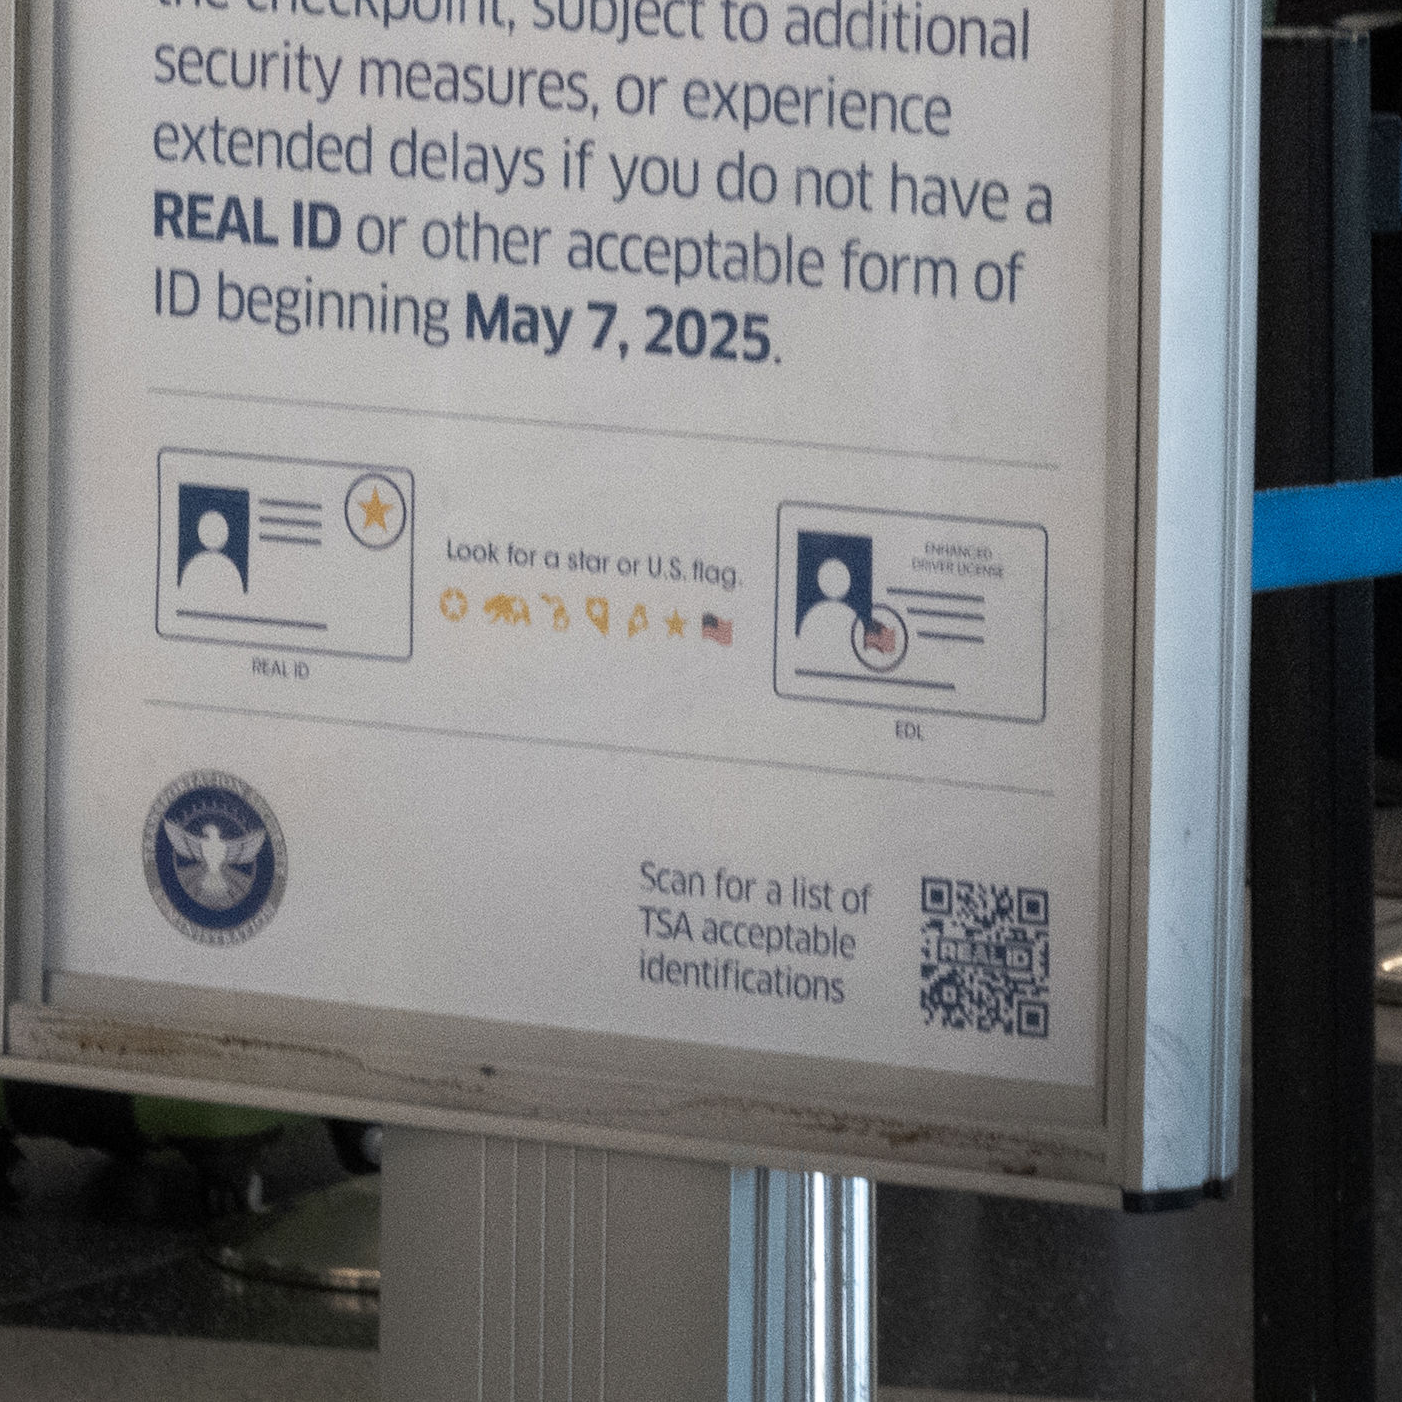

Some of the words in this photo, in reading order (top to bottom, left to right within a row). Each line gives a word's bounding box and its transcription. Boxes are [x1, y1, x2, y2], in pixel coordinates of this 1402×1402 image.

[155, 40, 343, 104] security
[360, 57, 599, 119] measures,
[616, 74, 668, 116] or
[683, 75, 952, 138] experience
[153, 117, 372, 175] extended
[389, 127, 545, 195] delays
[563, 137, 595, 190] if
[609, 153, 699, 204] you
[716, 150, 778, 205] do
[795, 161, 873, 212] not
[890, 161, 1009, 222] have
[1025, 182, 1053, 225] a
[154, 190, 279, 247] REAL
[293, 200, 342, 250] ID
[356, 214, 407, 255] or
[422, 210, 552, 266] other
[567, 229, 825, 288] acceptable
[841, 238, 957, 299] form
[974, 250, 1025, 304] of
[155, 267, 201, 318] ID
[218, 270, 450, 348] beginning
[466, 291, 573, 357] May
[587, 301, 629, 360] 7,
[644, 305, 781, 364] 2025.
[447, 539, 498, 563] Look
[507, 543, 536, 566] for
[544, 551, 560, 569] a
[568, 550, 609, 573] star
[617, 558, 639, 575] or
[648, 556, 687, 582] U.S.
[692, 559, 742, 591] flag.
[252, 657, 288, 678] REAL
[294, 660, 310, 679] ID
[895, 721, 923, 739] EDL
[640, 860, 705, 896] Scan
[715, 867, 756, 902] for
[766, 880, 782, 906] a
[792, 877, 833, 912] list
[841, 883, 871, 915] of
[639, 906, 693, 941] TSA
[702, 915, 857, 961] acceptable
[640, 948, 846, 1005] identifications
